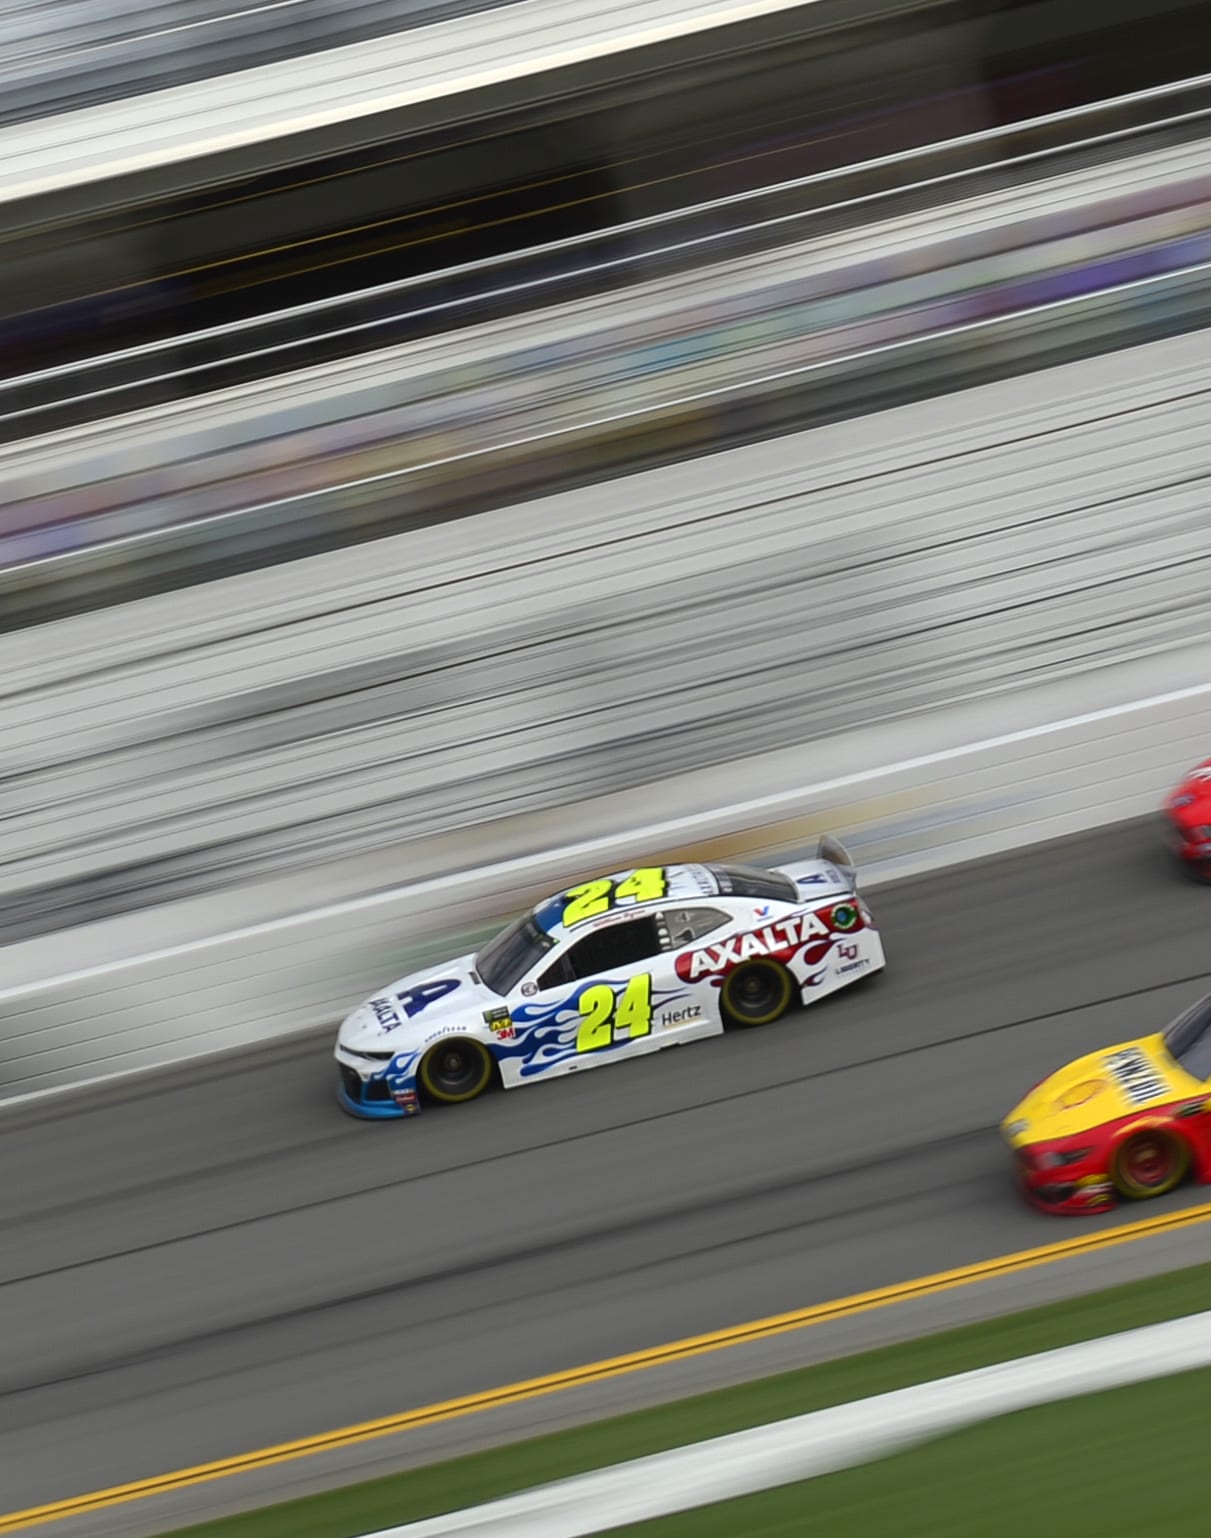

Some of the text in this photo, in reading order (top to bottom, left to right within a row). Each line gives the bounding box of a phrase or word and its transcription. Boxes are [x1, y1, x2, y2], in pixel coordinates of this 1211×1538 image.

[562, 866, 668, 928] 24
[689, 912, 830, 979] AXALTA
[575, 971, 653, 1054] 24
[662, 1004, 702, 1026] Hertz
